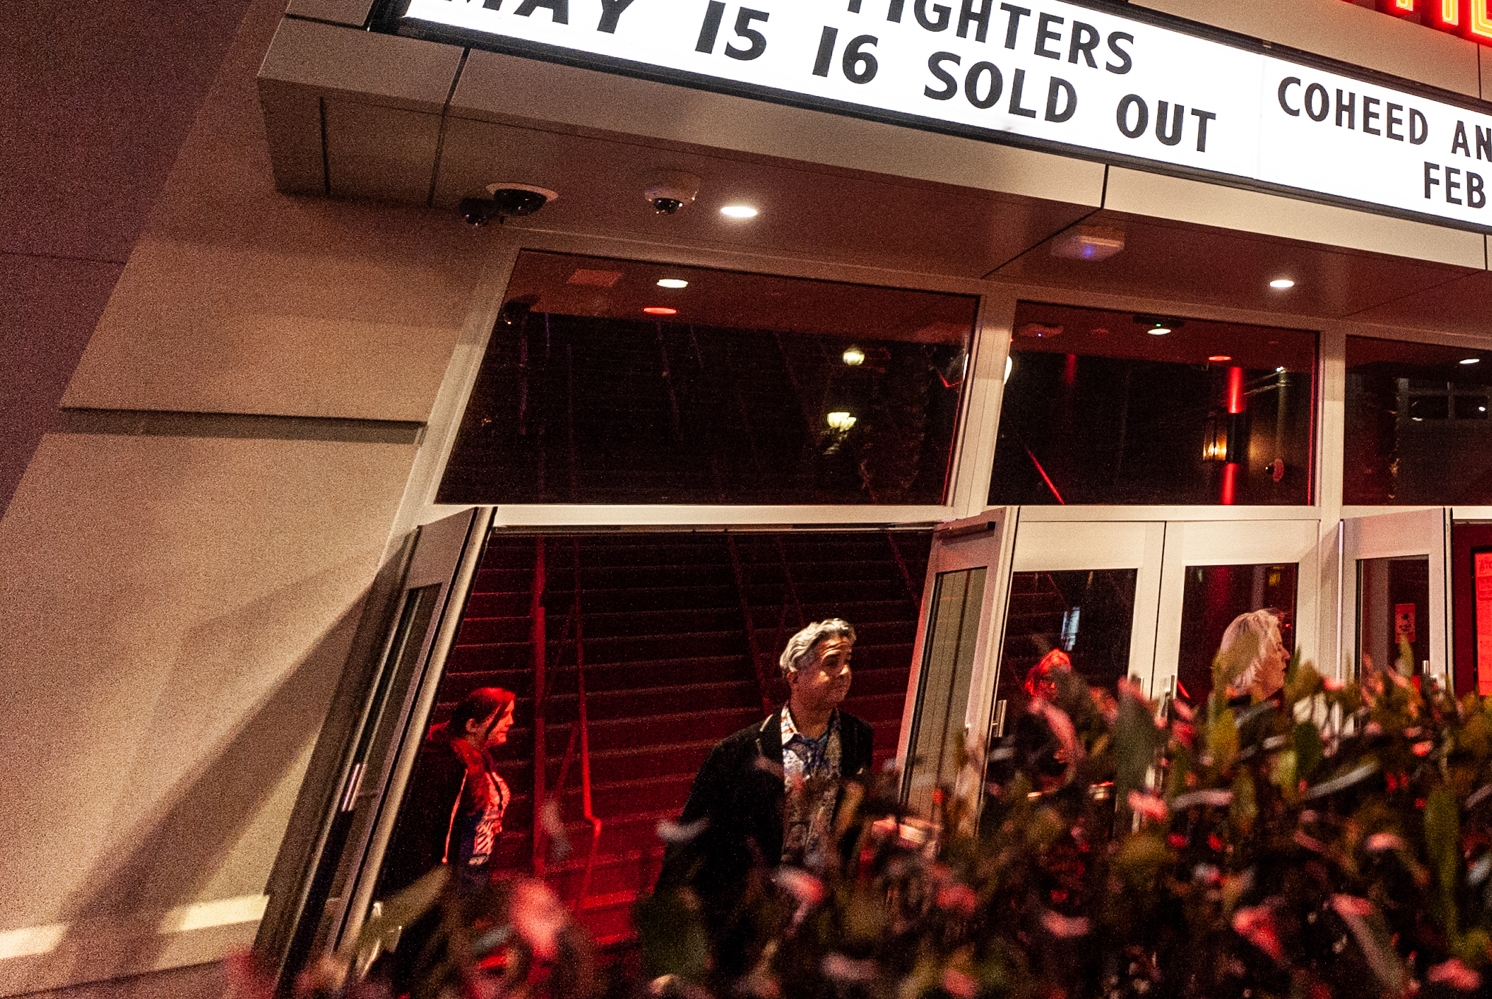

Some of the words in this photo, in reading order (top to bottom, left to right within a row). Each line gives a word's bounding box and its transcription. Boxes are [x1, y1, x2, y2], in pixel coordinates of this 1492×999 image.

[695, 0, 769, 60] 15
[812, 26, 878, 84] 16
[924, 52, 1077, 122] SOLD
[1117, 94, 1216, 152] OUT
[1278, 77, 1428, 145] COHEED
[1423, 161, 1486, 208] FEB
